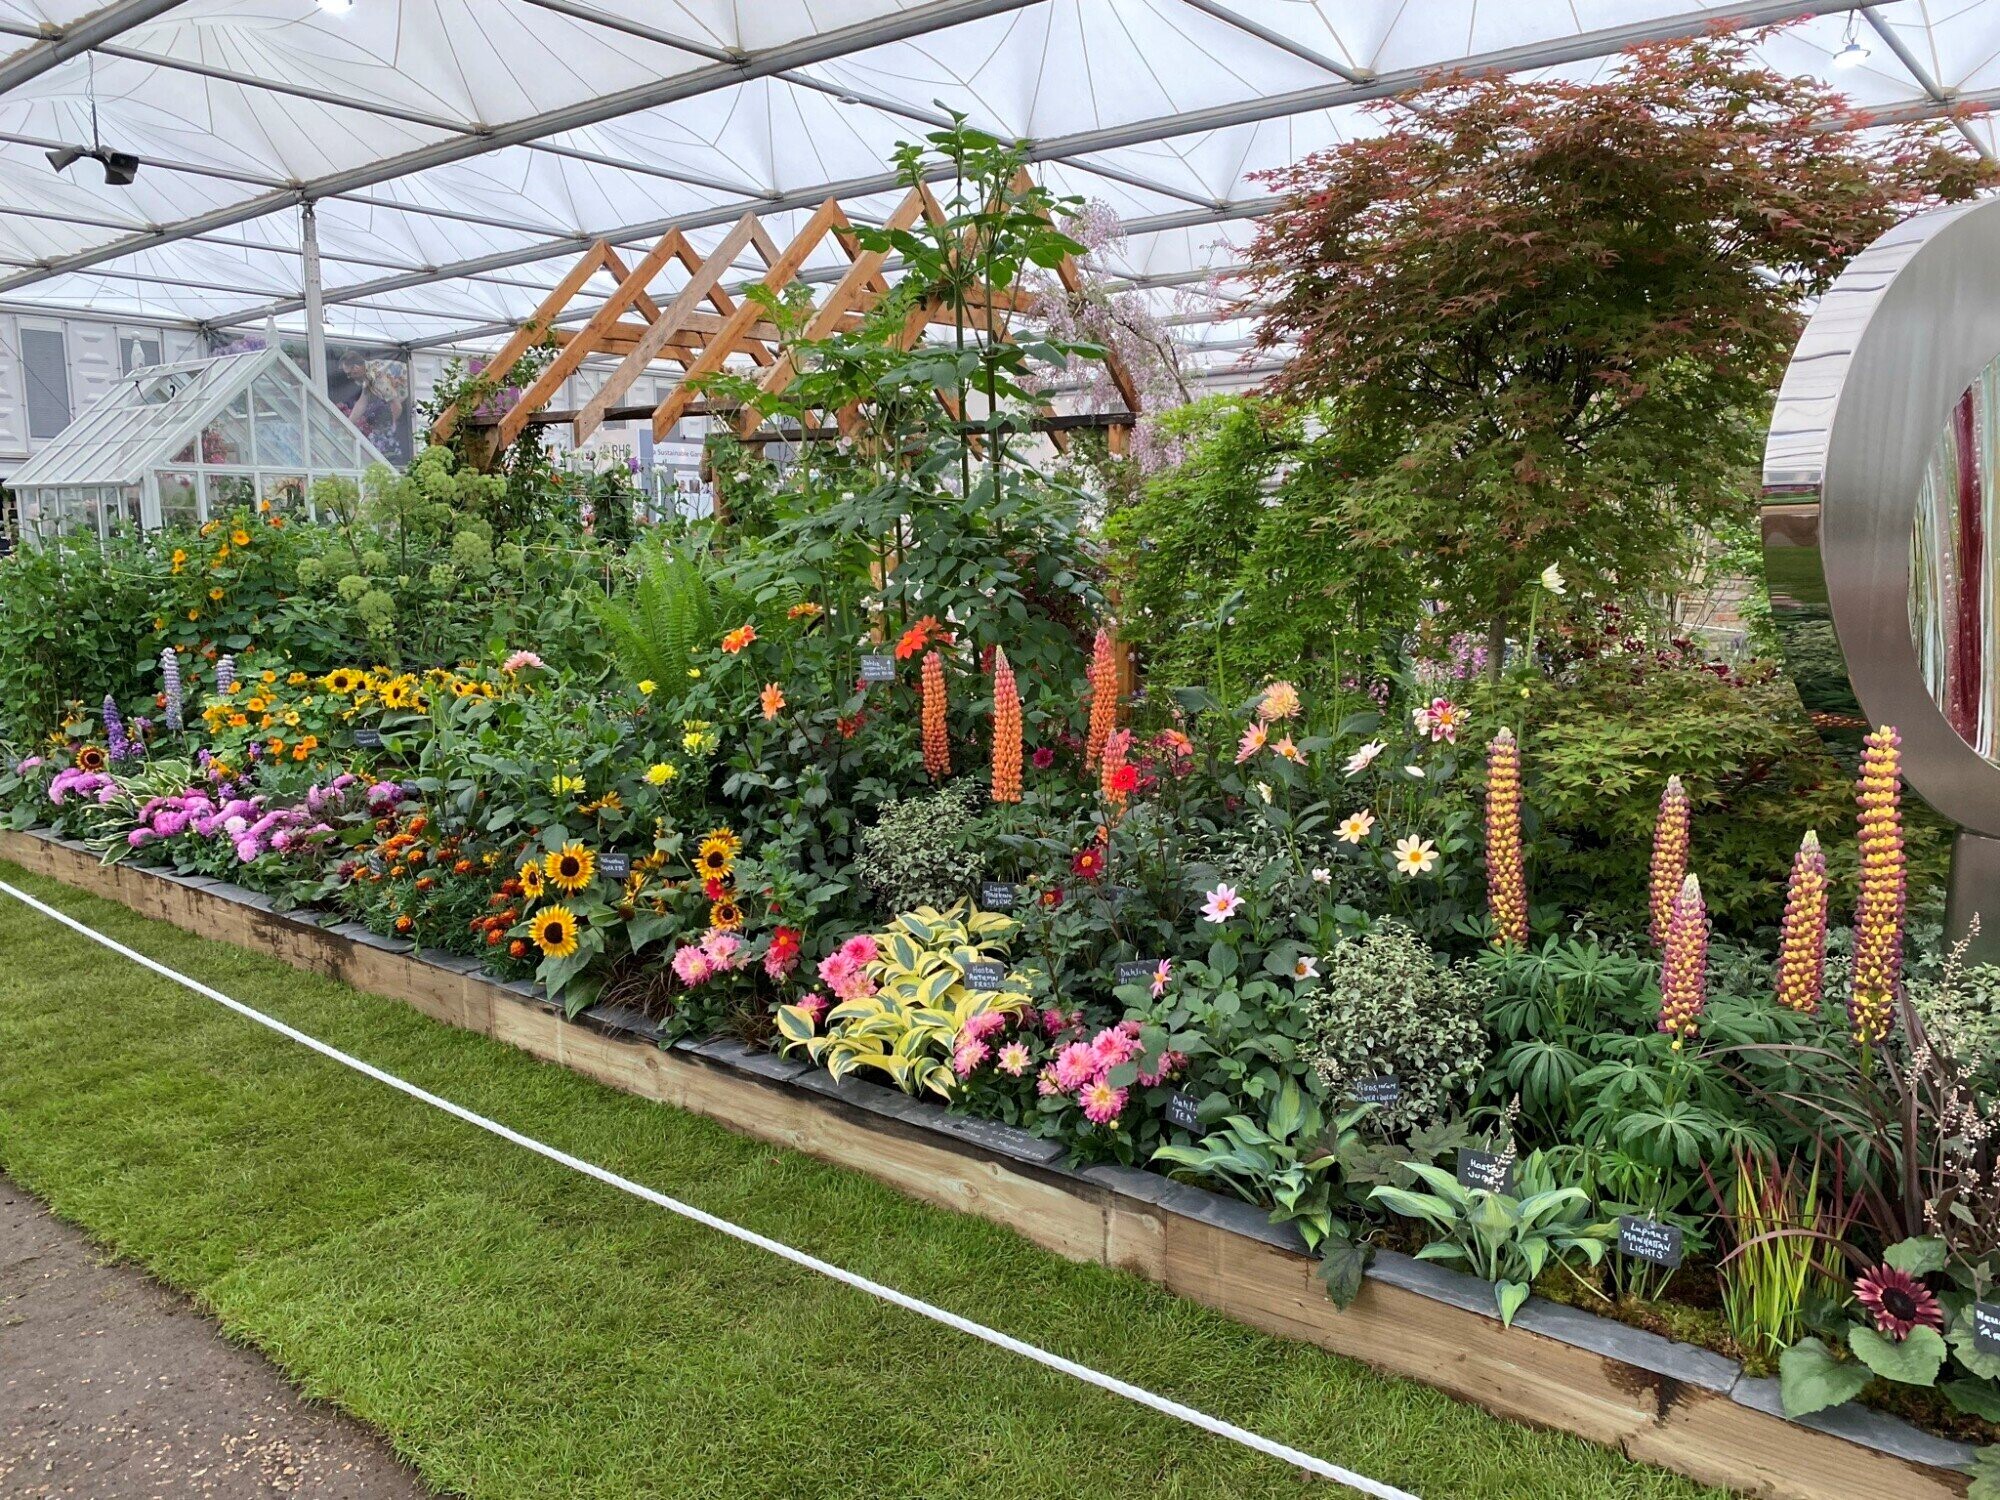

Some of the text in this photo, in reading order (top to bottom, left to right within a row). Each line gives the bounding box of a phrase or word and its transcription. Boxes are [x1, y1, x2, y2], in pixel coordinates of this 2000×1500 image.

[611, 444, 631, 457] RHS
[657, 449, 689, 457] Sustainable
[972, 966, 995, 974] Hosta
[1120, 967, 1149, 977] Dahlia
